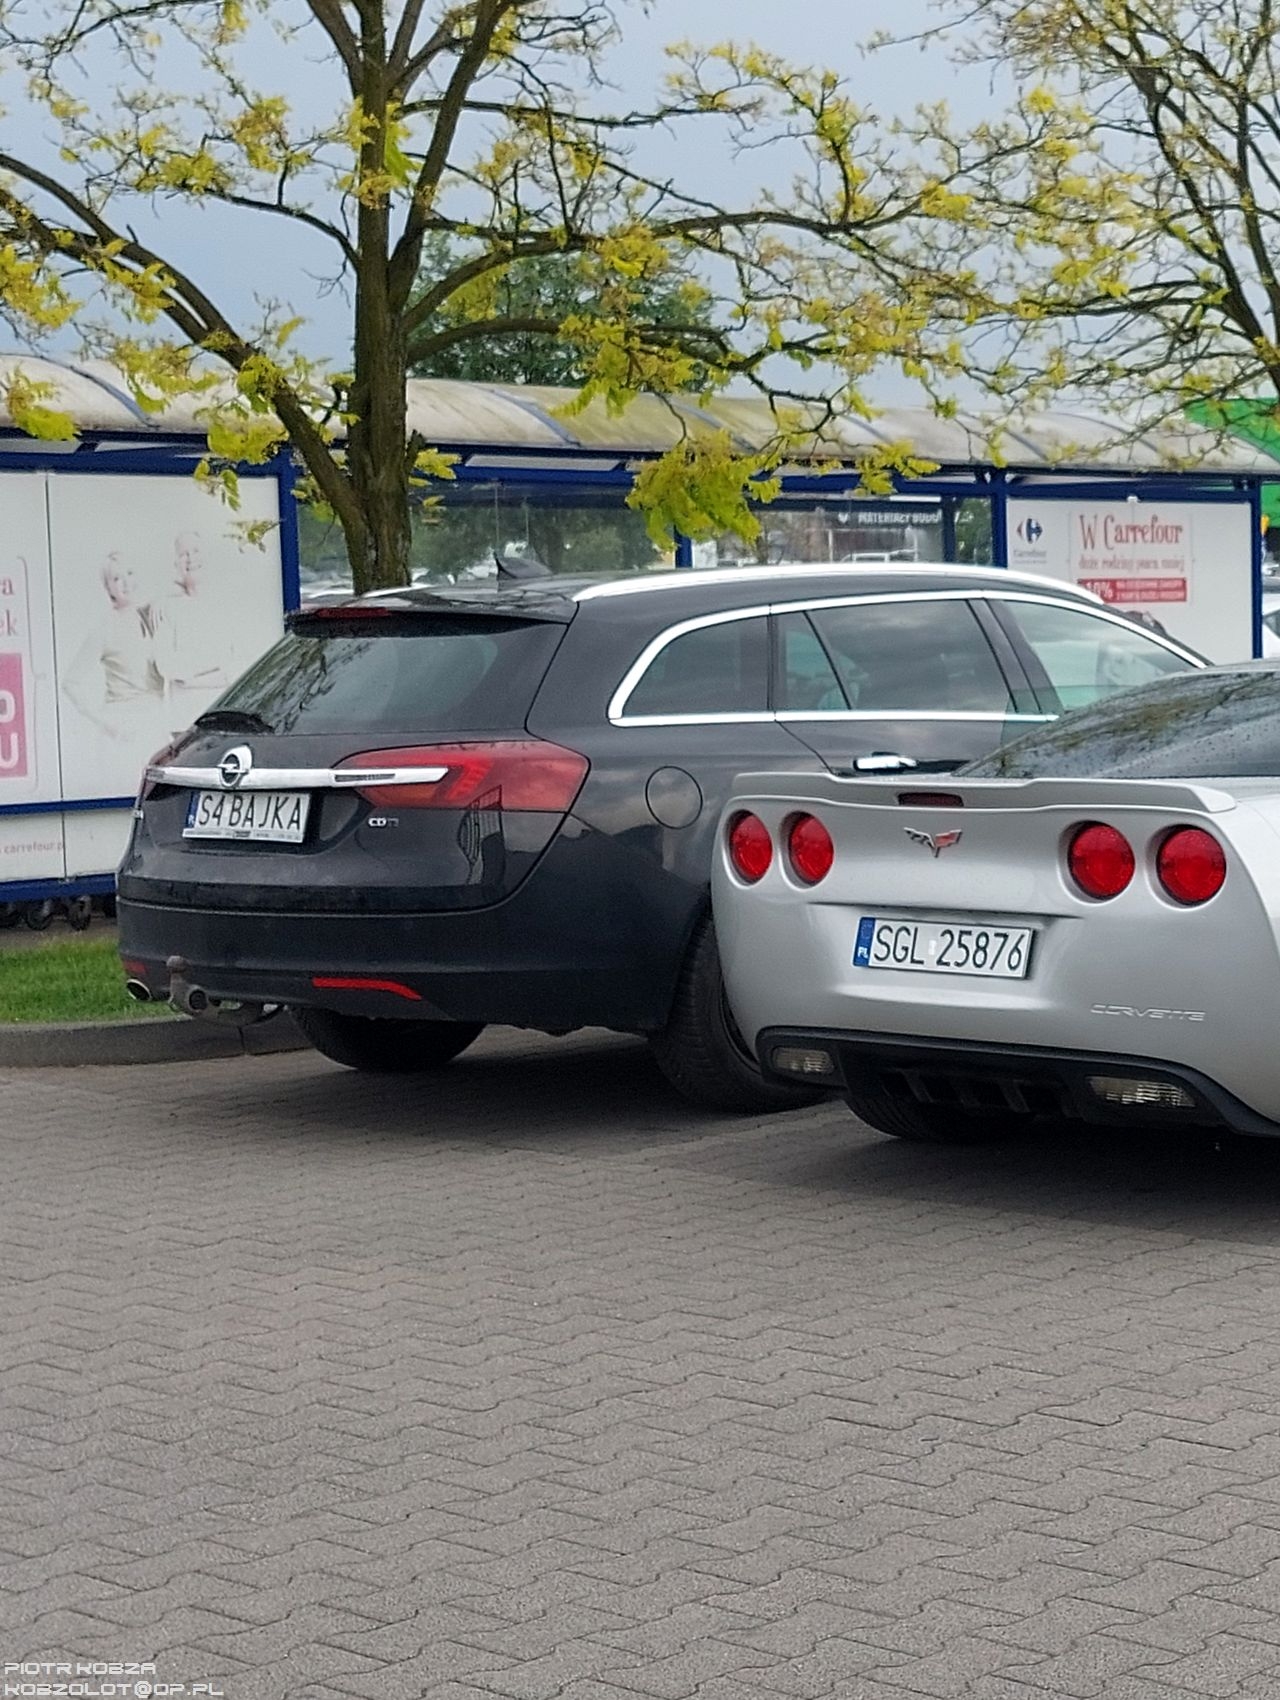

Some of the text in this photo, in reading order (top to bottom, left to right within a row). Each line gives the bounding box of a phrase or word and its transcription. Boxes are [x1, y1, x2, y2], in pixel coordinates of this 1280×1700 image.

[1079, 513, 1183, 550] W Carrefour
[874, 924, 1026, 972] SGL 25876
[1089, 1003, 1206, 1022] CORVETTE
